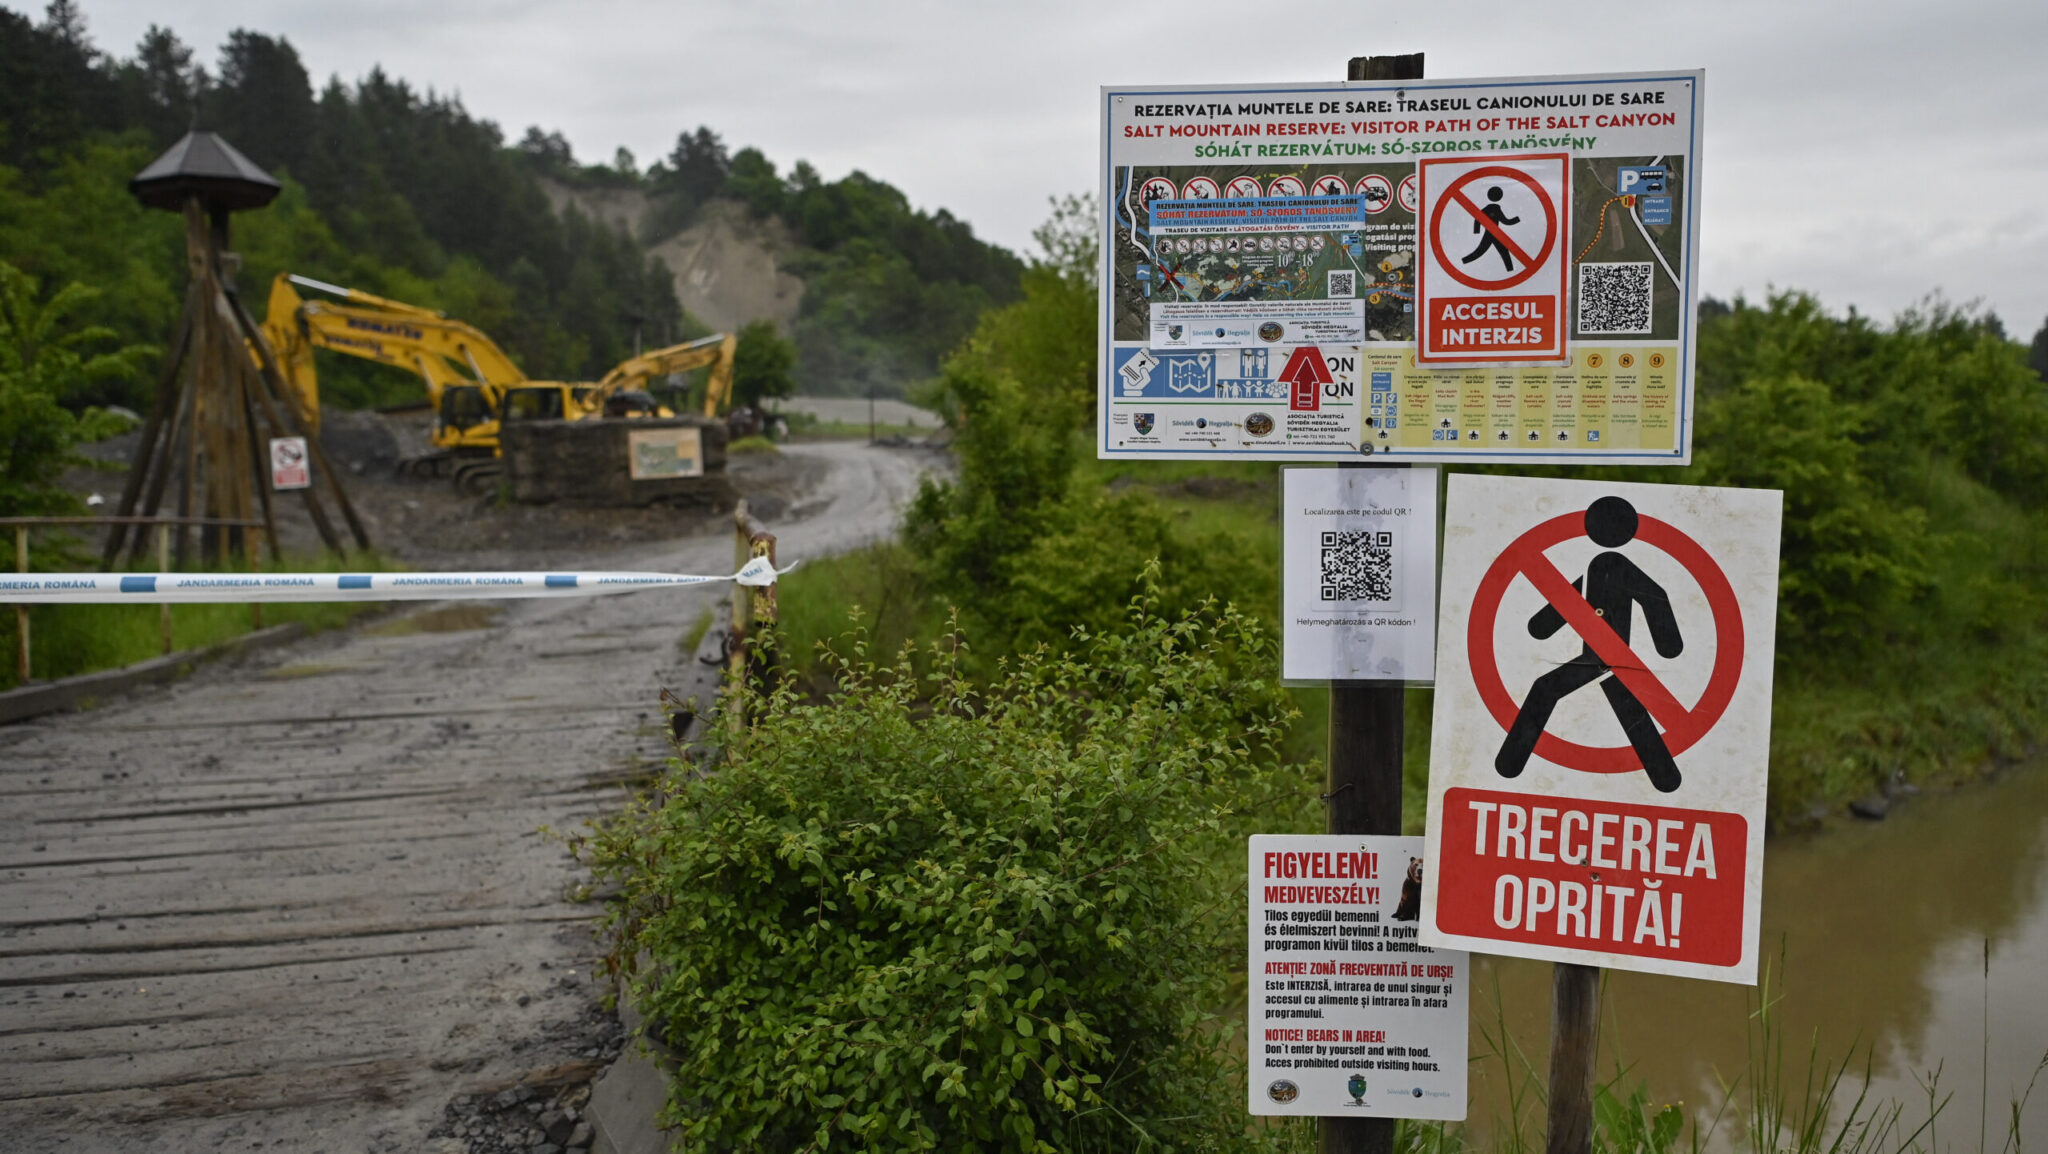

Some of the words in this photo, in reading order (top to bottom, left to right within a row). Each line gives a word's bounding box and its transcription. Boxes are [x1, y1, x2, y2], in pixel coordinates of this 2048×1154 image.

[1134, 103, 1232, 119] REZERVAȚIA
[1239, 102, 1316, 115] MUNTELE
[1319, 101, 1340, 114] DE
[1345, 100, 1392, 113] SARE:
[1397, 98, 1471, 112] TRASEUL
[1476, 95, 1586, 110] CANIONULUI
[1592, 94, 1615, 106] DE
[1620, 92, 1665, 105] SARE
[1124, 124, 1165, 138] SALT
[1169, 123, 1260, 137] MOUNTAIN
[1266, 122, 1346, 136] RESERVE:
[1350, 120, 1418, 135] VISITOR
[1425, 119, 1470, 132] PATH
[1477, 118, 1501, 131] OF
[1506, 117, 1540, 130] THE
[1546, 115, 1590, 129] SALT
[1595, 112, 1675, 127] CANYON
[1195, 141, 1252, 158] SÓHÁT
[1257, 139, 1376, 157] REZERVÁTUM:
[1381, 138, 1482, 155] SÓ-SZOROS
[1621, 170, 1639, 192] P
[1366, 224, 1388, 233] gram
[1390, 223, 1400, 231] de
[1366, 233, 1397, 242] ogatási
[1441, 302, 1544, 321] ACCESUL
[1442, 327, 1543, 345] INTERZIS
[1327, 357, 1354, 372] ON
[1591, 357, 1599, 365] 7
[1623, 357, 1630, 365] 8
[1653, 356, 1661, 365] 9
[1325, 382, 1353, 397] ON
[1304, 508, 1345, 516] Localizarea
[1362, 509, 1371, 517] pe
[1394, 508, 1407, 516] QR
[177, 580, 261, 588] JANDARMERIA
[392, 578, 472, 586] JANDARMERIA
[1297, 618, 1366, 627] Helymeghatározás
[1374, 618, 1387, 626] QR
[1388, 618, 1412, 626] kódon
[1468, 800, 1717, 880] TRECEREA
[1264, 852, 1378, 879] FIGYELEM!
[1264, 882, 1380, 904] MEDVEVESZÉLY!
[1265, 910, 1289, 922] Tilos
[1291, 910, 1332, 923] egyedül
[1335, 910, 1380, 923] bemenni
[1493, 874, 1683, 949] OPRITĂ!
[1265, 924, 1277, 936] és
[1280, 924, 1337, 936] élelmiszert
[1339, 925, 1380, 937] bevinni!
[1383, 926, 1390, 937] A
[1392, 926, 1418, 939] nyitv
[1265, 940, 1321, 952] programon
[1352, 939, 1374, 951] tilos
[1377, 942, 1384, 951] a
[1265, 962, 1307, 978] ATENȚIE!
[1310, 960, 1336, 975] ZONĂ
[1339, 961, 1407, 977] FRECVENTATĂ
[1411, 964, 1424, 977] DE
[1427, 965, 1454, 982] URȘI!
[1265, 980, 1285, 990] Este
[1287, 979, 1332, 992] INTERZISĂ,
[1334, 981, 1371, 992] intrarea
[1373, 981, 1385, 992] de
[1388, 981, 1408, 993] unul
[1411, 982, 1440, 995] singur
[1444, 983, 1452, 997] și
[1265, 995, 1302, 1005] accesul
[1304, 996, 1316, 1005] cu
[1318, 995, 1358, 1006] alimente
[1361, 995, 1370, 1009] și
[1372, 996, 1409, 1007] intrarea
[1412, 995, 1421, 1007] în
[1423, 997, 1448, 1008] afara
[1265, 1009, 1325, 1019] programului.
[1265, 1029, 1304, 1042] NOTICE!
[1307, 1029, 1339, 1042] BEARS
[1342, 1030, 1353, 1042] IN
[1356, 1030, 1386, 1043] AREA!
[1291, 1045, 1314, 1054] enter
[1316, 1045, 1327, 1056] by
[1329, 1045, 1365, 1056] yourself
[1368, 1045, 1384, 1056] and
[1386, 1046, 1406, 1057] with
[1408, 1047, 1431, 1058] food.
[1265, 1058, 1292, 1068] Acces
[1294, 1058, 1339, 1069] prohibited
[1341, 1059, 1374, 1069] outside
[1377, 1060, 1410, 1071] visiting
[1412, 1061, 1440, 1072] hours.
